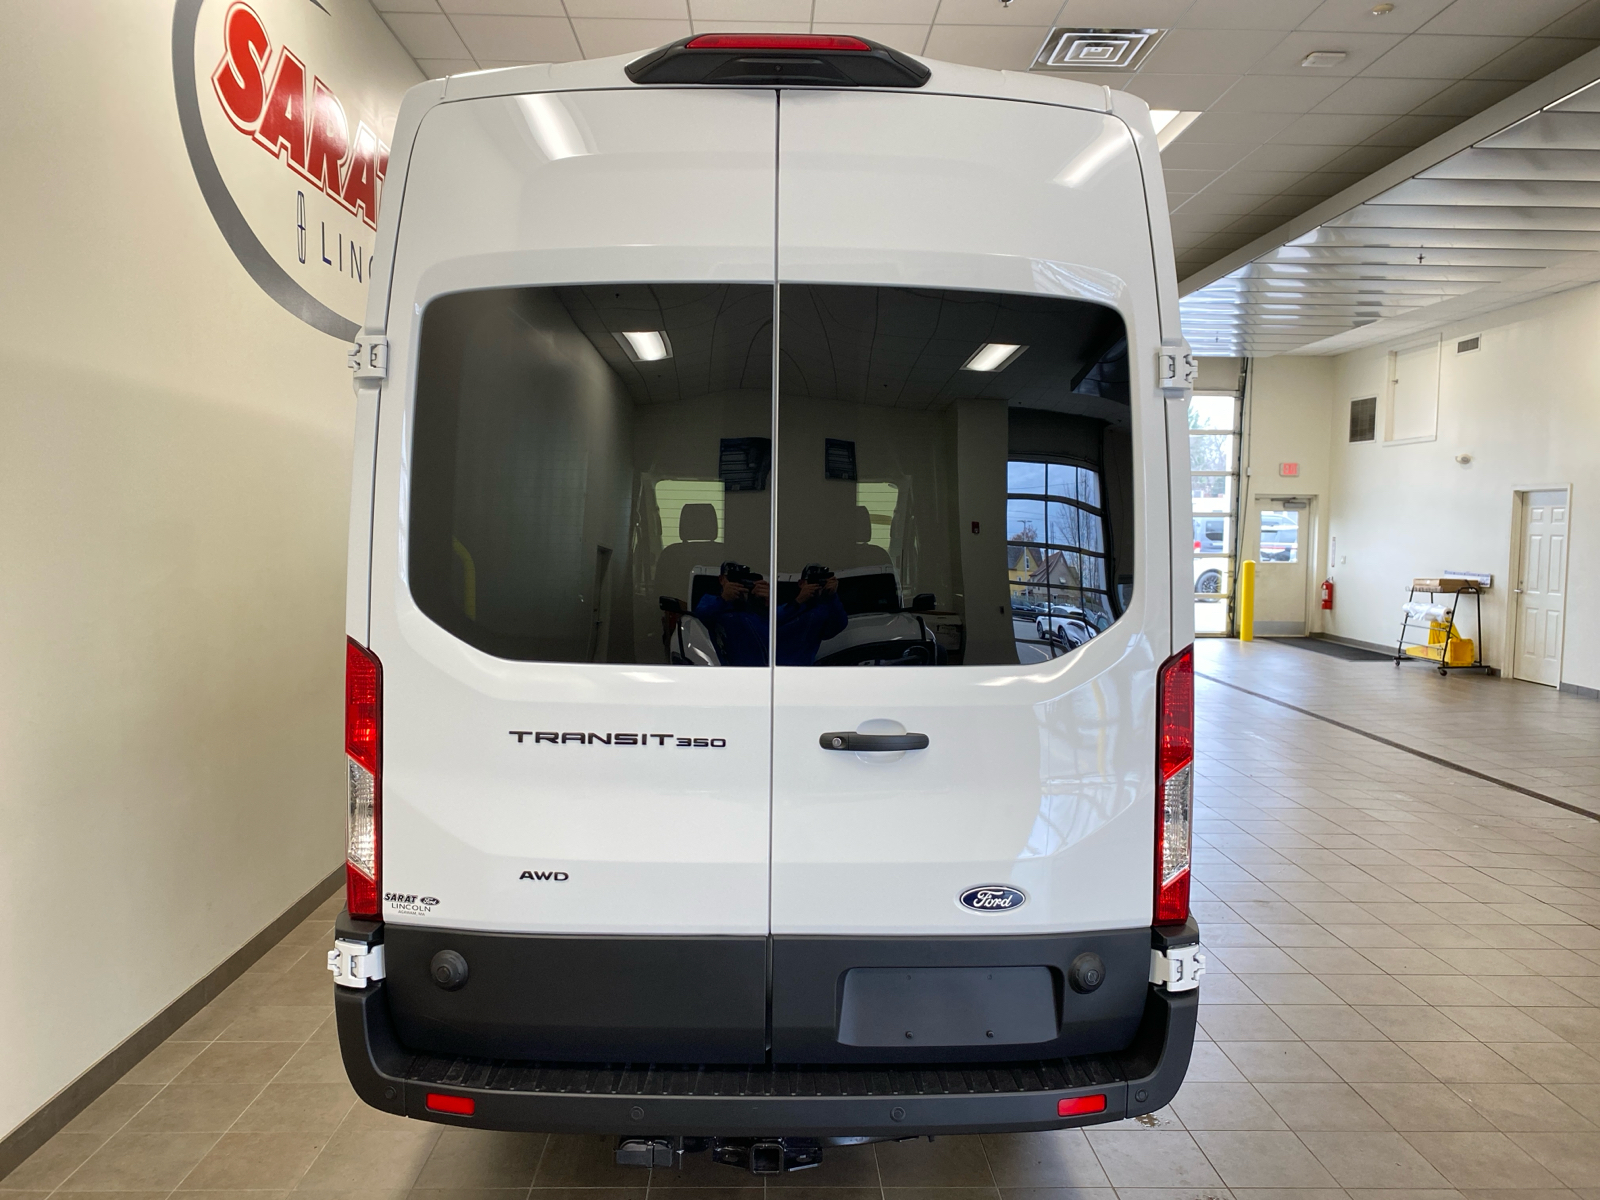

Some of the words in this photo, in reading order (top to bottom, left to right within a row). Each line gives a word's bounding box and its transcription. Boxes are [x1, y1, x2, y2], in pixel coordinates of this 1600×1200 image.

[321, 221, 373, 283] LIN
[518, 870, 570, 882] AWD
[384, 892, 418, 904] SARAT
[973, 890, 1013, 907] Ford
[391, 902, 431, 912] LINCOLN
